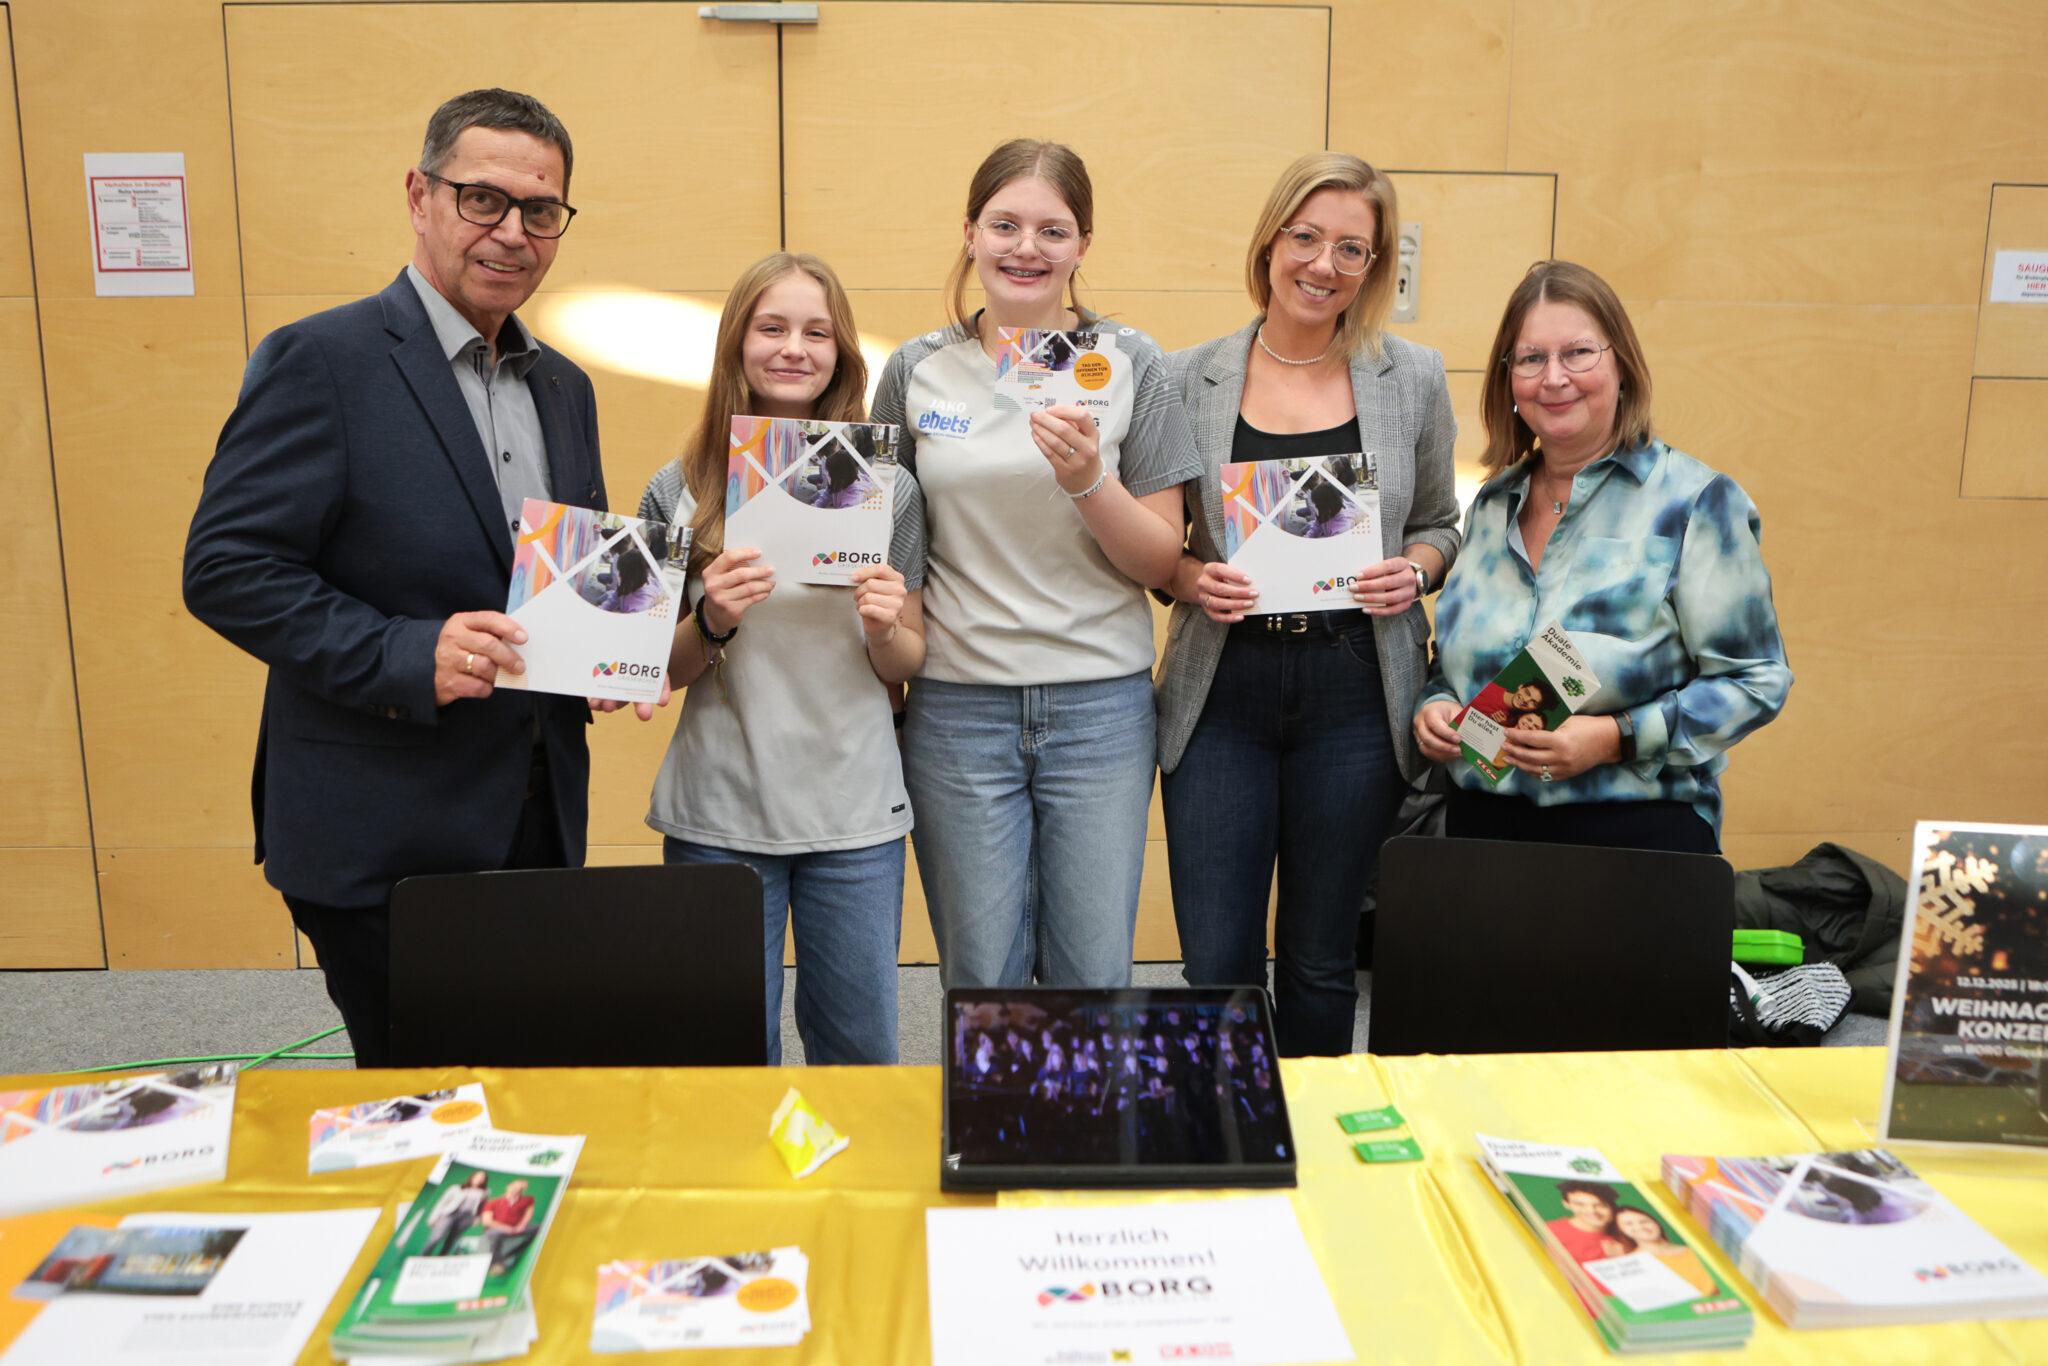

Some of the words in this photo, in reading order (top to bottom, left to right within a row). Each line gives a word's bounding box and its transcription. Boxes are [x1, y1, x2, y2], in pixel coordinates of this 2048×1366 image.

[2018, 264, 2048, 273] SAUG
[928, 400, 967, 413] JAKO
[1088, 399, 1109, 407] BORG
[838, 551, 882, 565] BORG
[1336, 576, 1358, 588] BO
[1547, 627, 1572, 650] Duale
[1541, 634, 1582, 671] Akademie
[618, 662, 661, 679] BORG
[1468, 715, 1477, 724] Du
[1470, 710, 1484, 722] Hier
[1485, 719, 1500, 732] hast
[1931, 996, 2048, 1021] WEIHNAC
[1958, 1020, 2048, 1043] KONZE
[145, 1145, 215, 1165] BORG
[1056, 1227, 1169, 1247] Herzlich
[1018, 1248, 1216, 1273] Willkommen!
[1947, 1258, 2020, 1276] BORG
[1101, 1276, 1213, 1298] BORG
